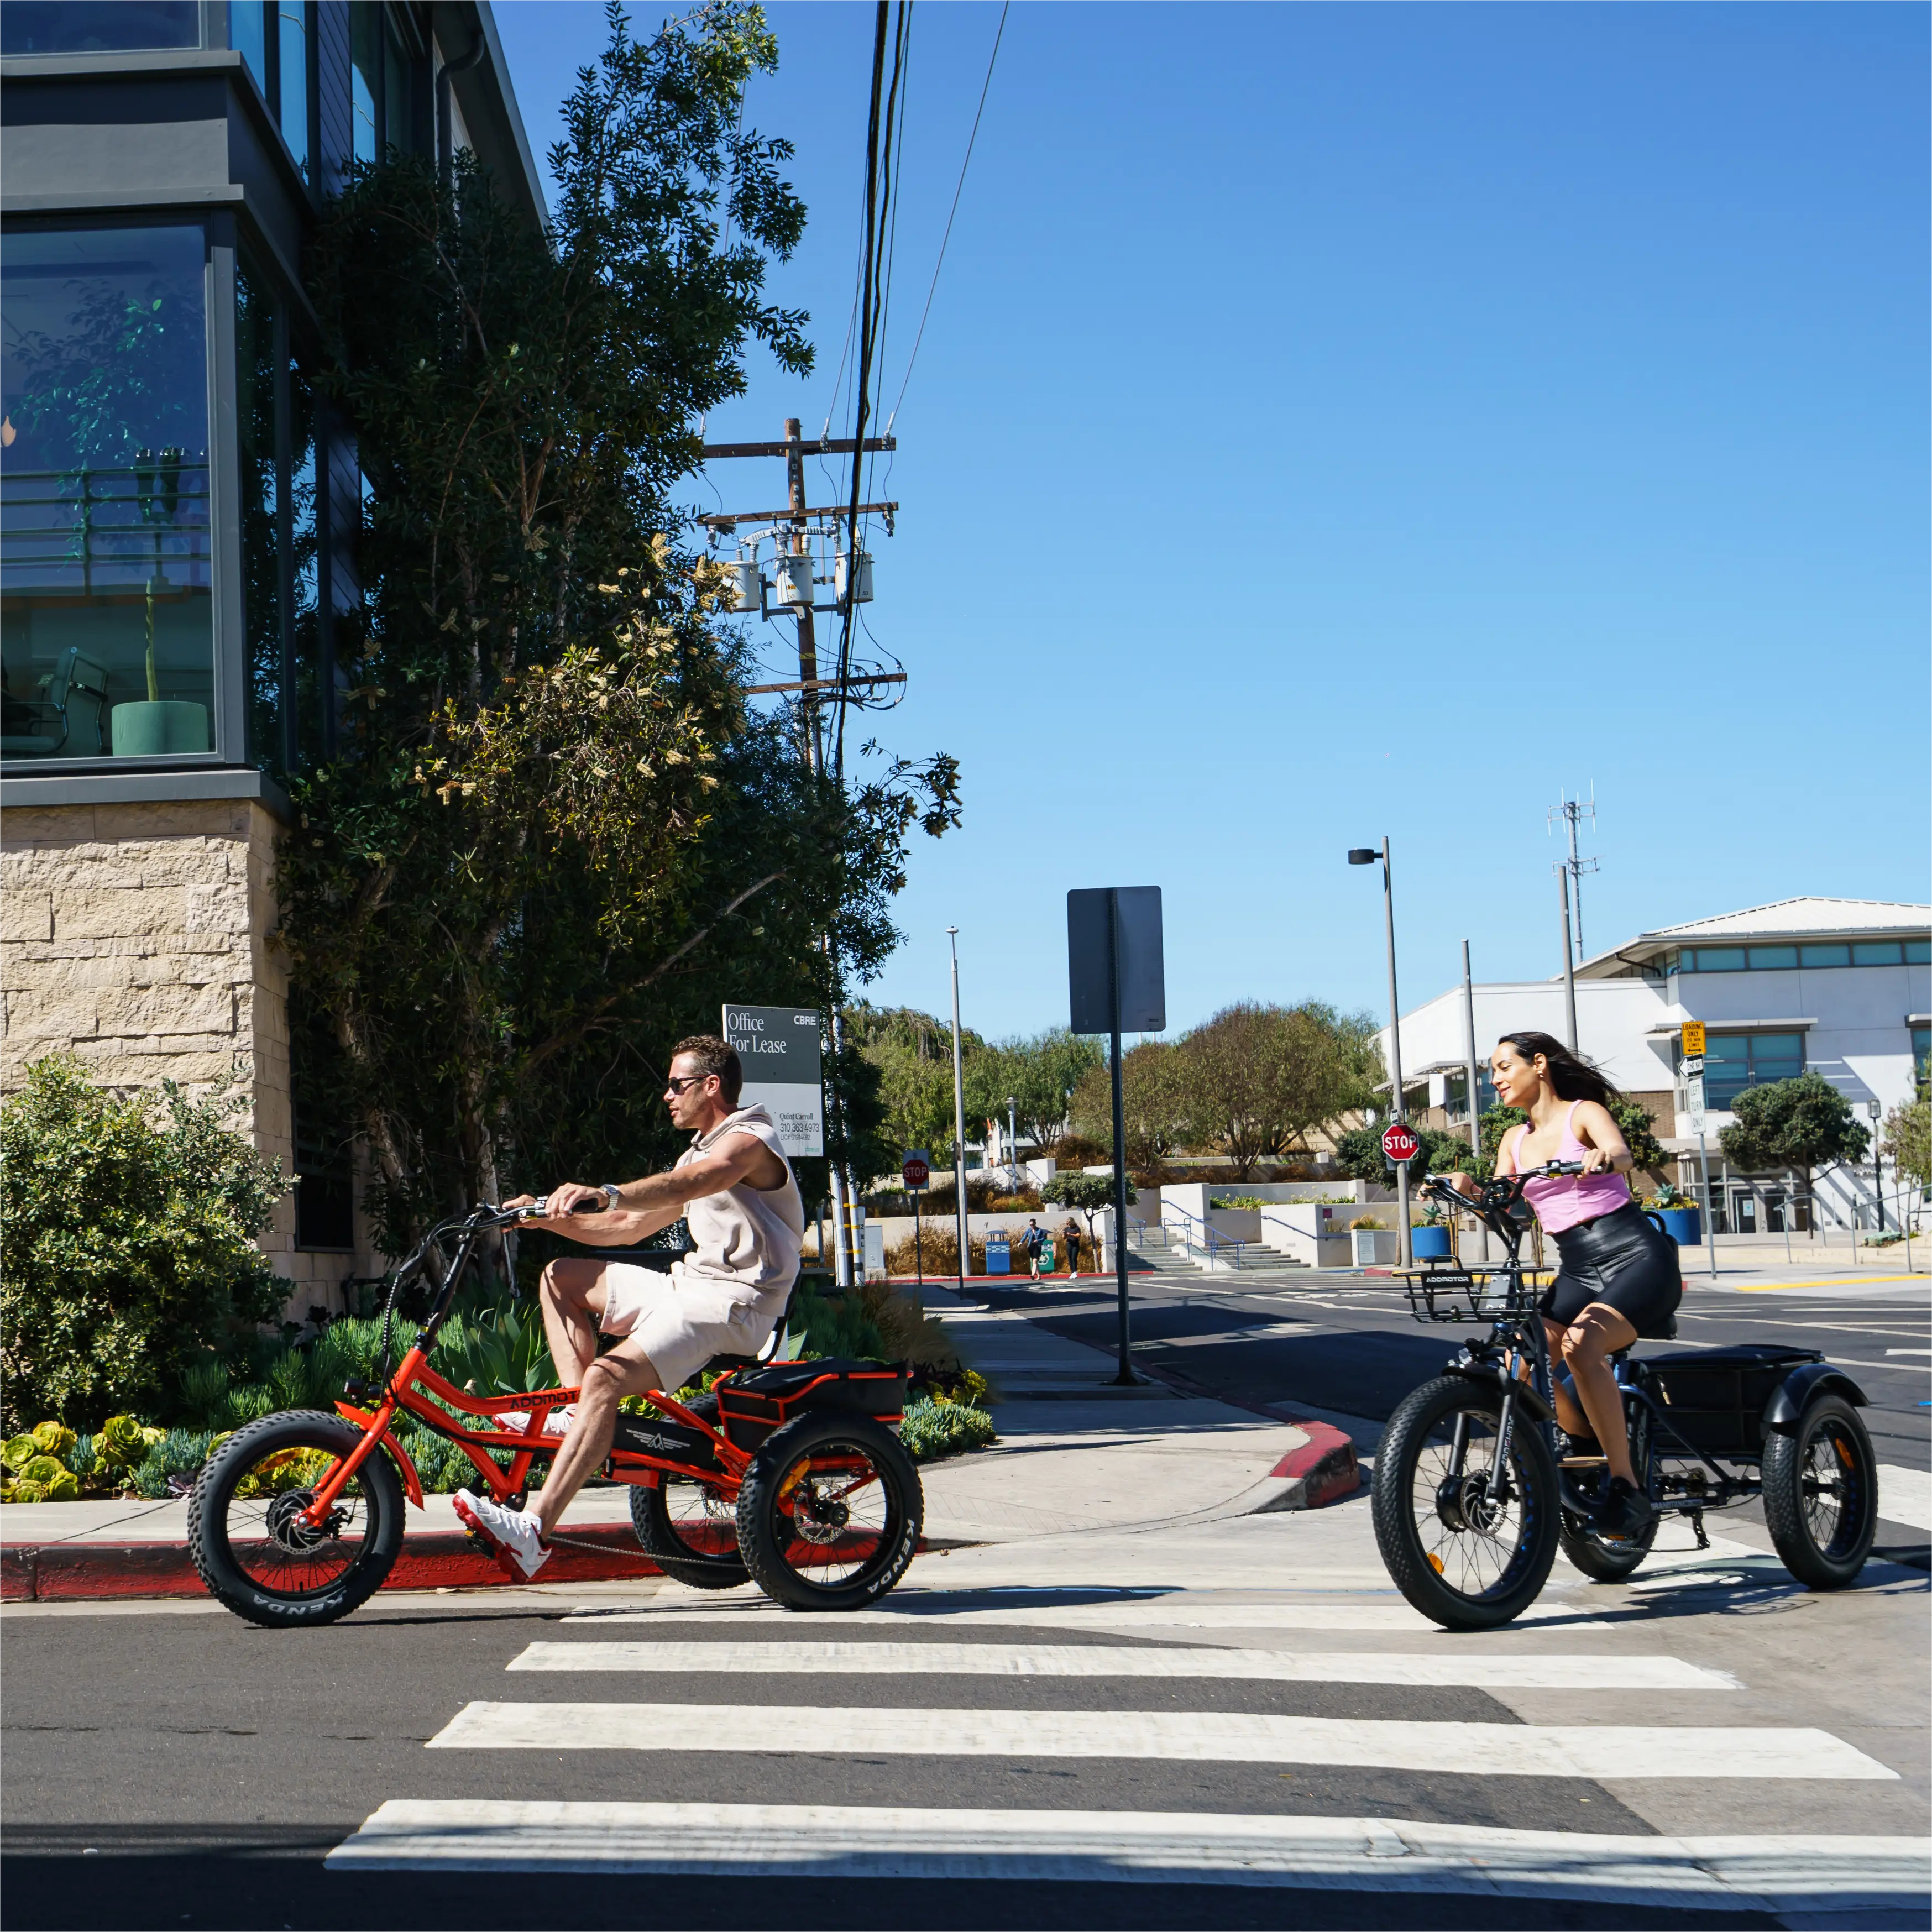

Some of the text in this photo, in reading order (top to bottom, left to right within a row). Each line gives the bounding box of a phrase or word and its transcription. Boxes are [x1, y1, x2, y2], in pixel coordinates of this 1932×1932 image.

[727, 1013, 765, 1032] Office
[794, 1015, 816, 1026] CBRE
[729, 1034, 787, 1054] For Lease
[1691, 1084, 1700, 1096] LEFT
[1691, 1100, 1702, 1112] TURN
[779, 1113, 794, 1121] Quint
[1693, 1117, 1703, 1128] ONLY
[780, 1123, 819, 1132] 310 363 4973
[1385, 1135, 1416, 1150] STOP
[904, 1167, 927, 1177] STOP
[510, 1390, 580, 1409] ADDMOT
[867, 1519, 914, 1593] KENDA
[253, 1590, 347, 1615] KENDA
